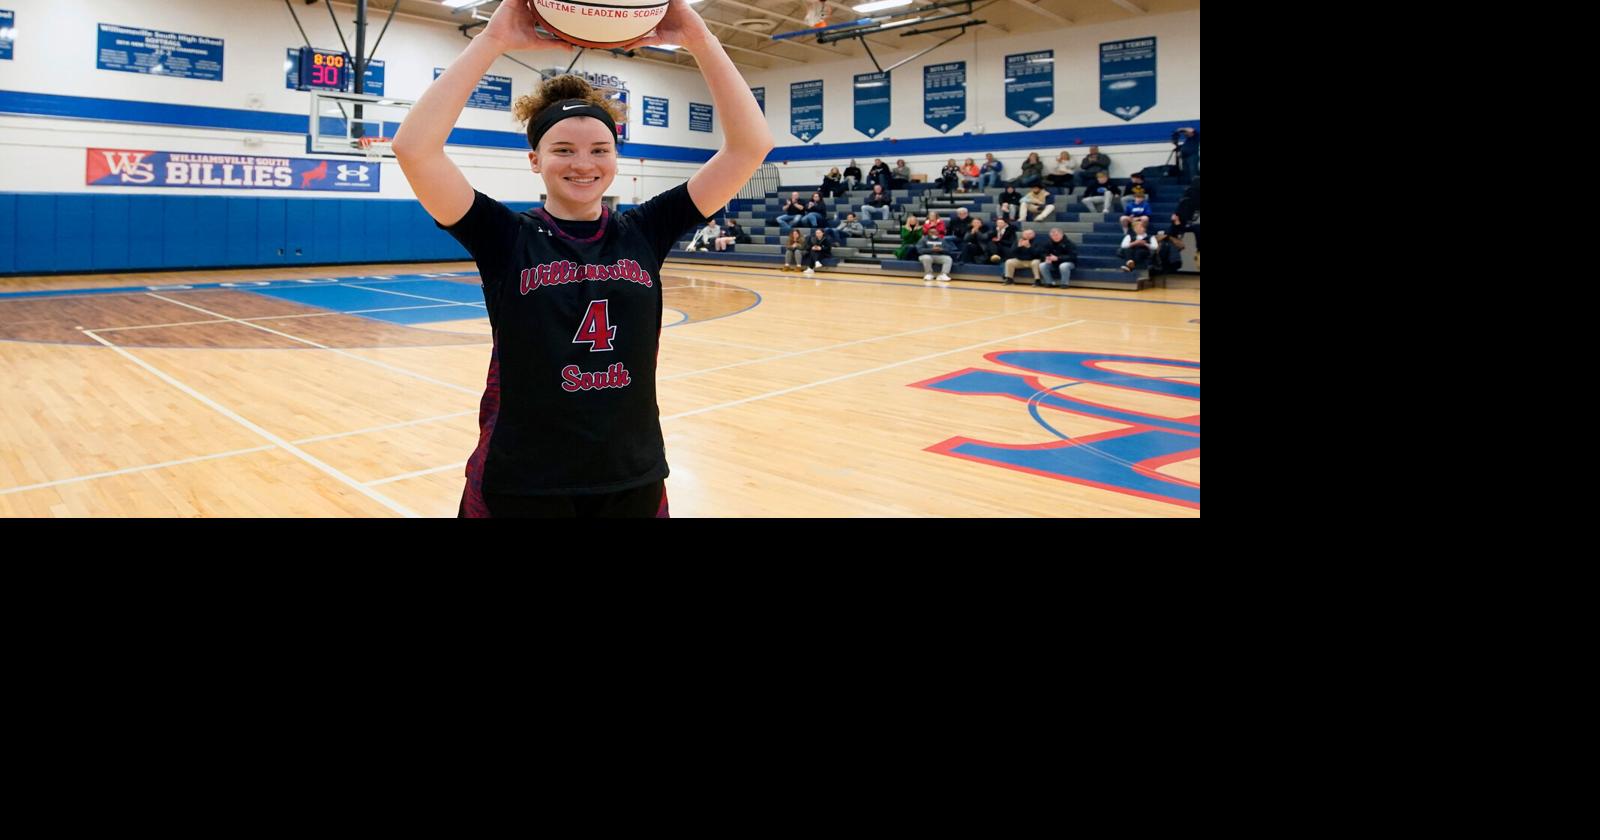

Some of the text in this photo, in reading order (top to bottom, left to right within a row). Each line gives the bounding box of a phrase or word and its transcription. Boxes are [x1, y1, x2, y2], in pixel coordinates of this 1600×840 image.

[581, 7, 629, 18] LEADING
[633, 7, 664, 17] SCORER
[154, 31, 177, 40] South
[178, 33, 198, 43] High
[198, 36, 223, 46] School
[314, 53, 344, 68] 8:00
[311, 64, 339, 85] 30
[169, 153, 290, 167] WILLIAMSVILLE SOUTH
[165, 162, 293, 188] BILLIES
[520, 259, 653, 295] Williamsville
[572, 299, 617, 352] 4
[561, 362, 632, 392] South
